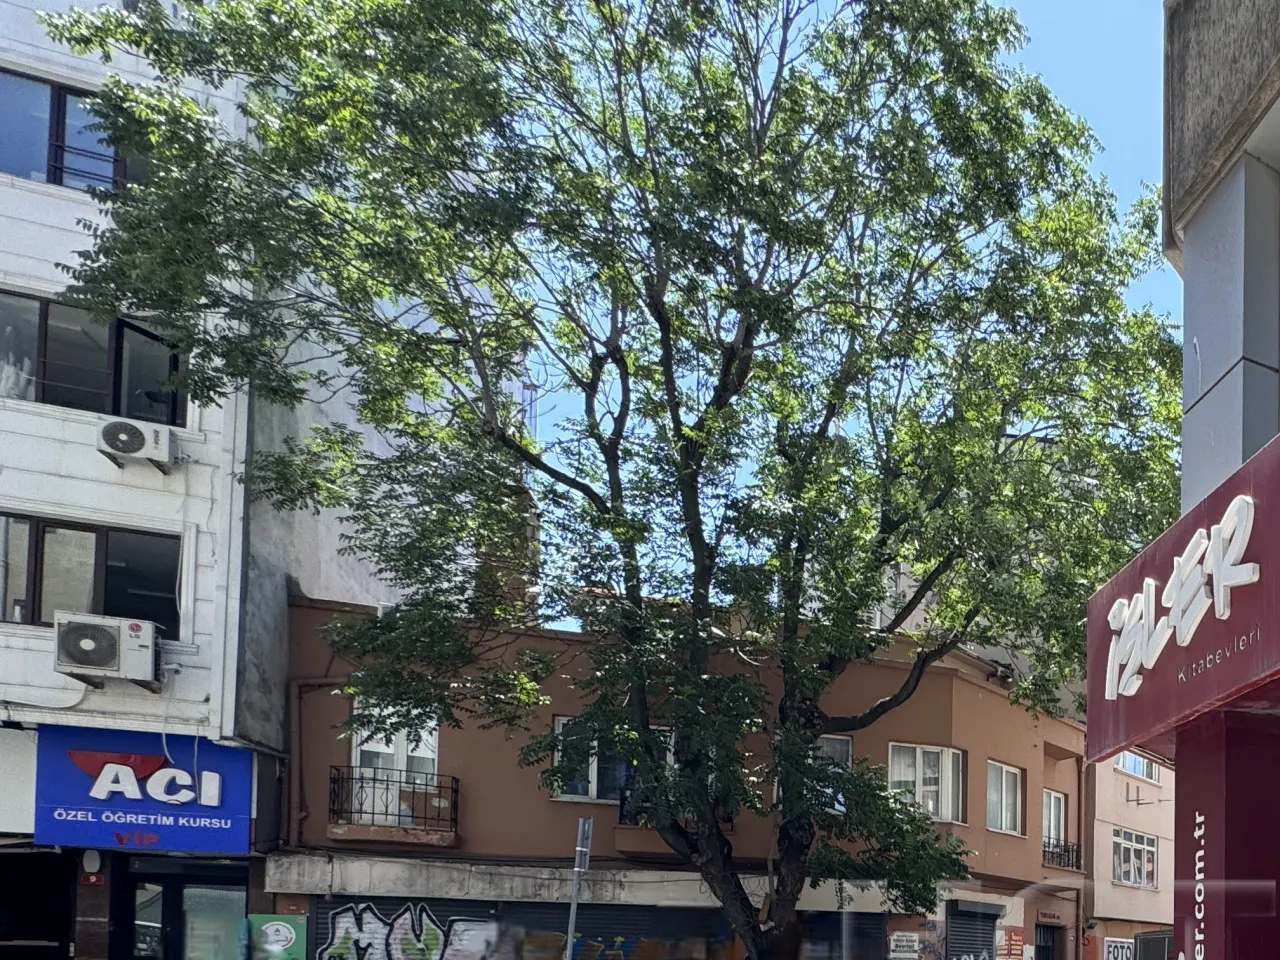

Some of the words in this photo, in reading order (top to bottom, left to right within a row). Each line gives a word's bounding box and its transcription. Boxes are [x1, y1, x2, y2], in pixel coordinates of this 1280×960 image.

[1177, 623, 1260, 684] Kitabevleri
[53, 808, 98, 822] ÖZEL
[101, 810, 174, 826] ÖĞRETİM
[179, 816, 232, 829] KURSU
